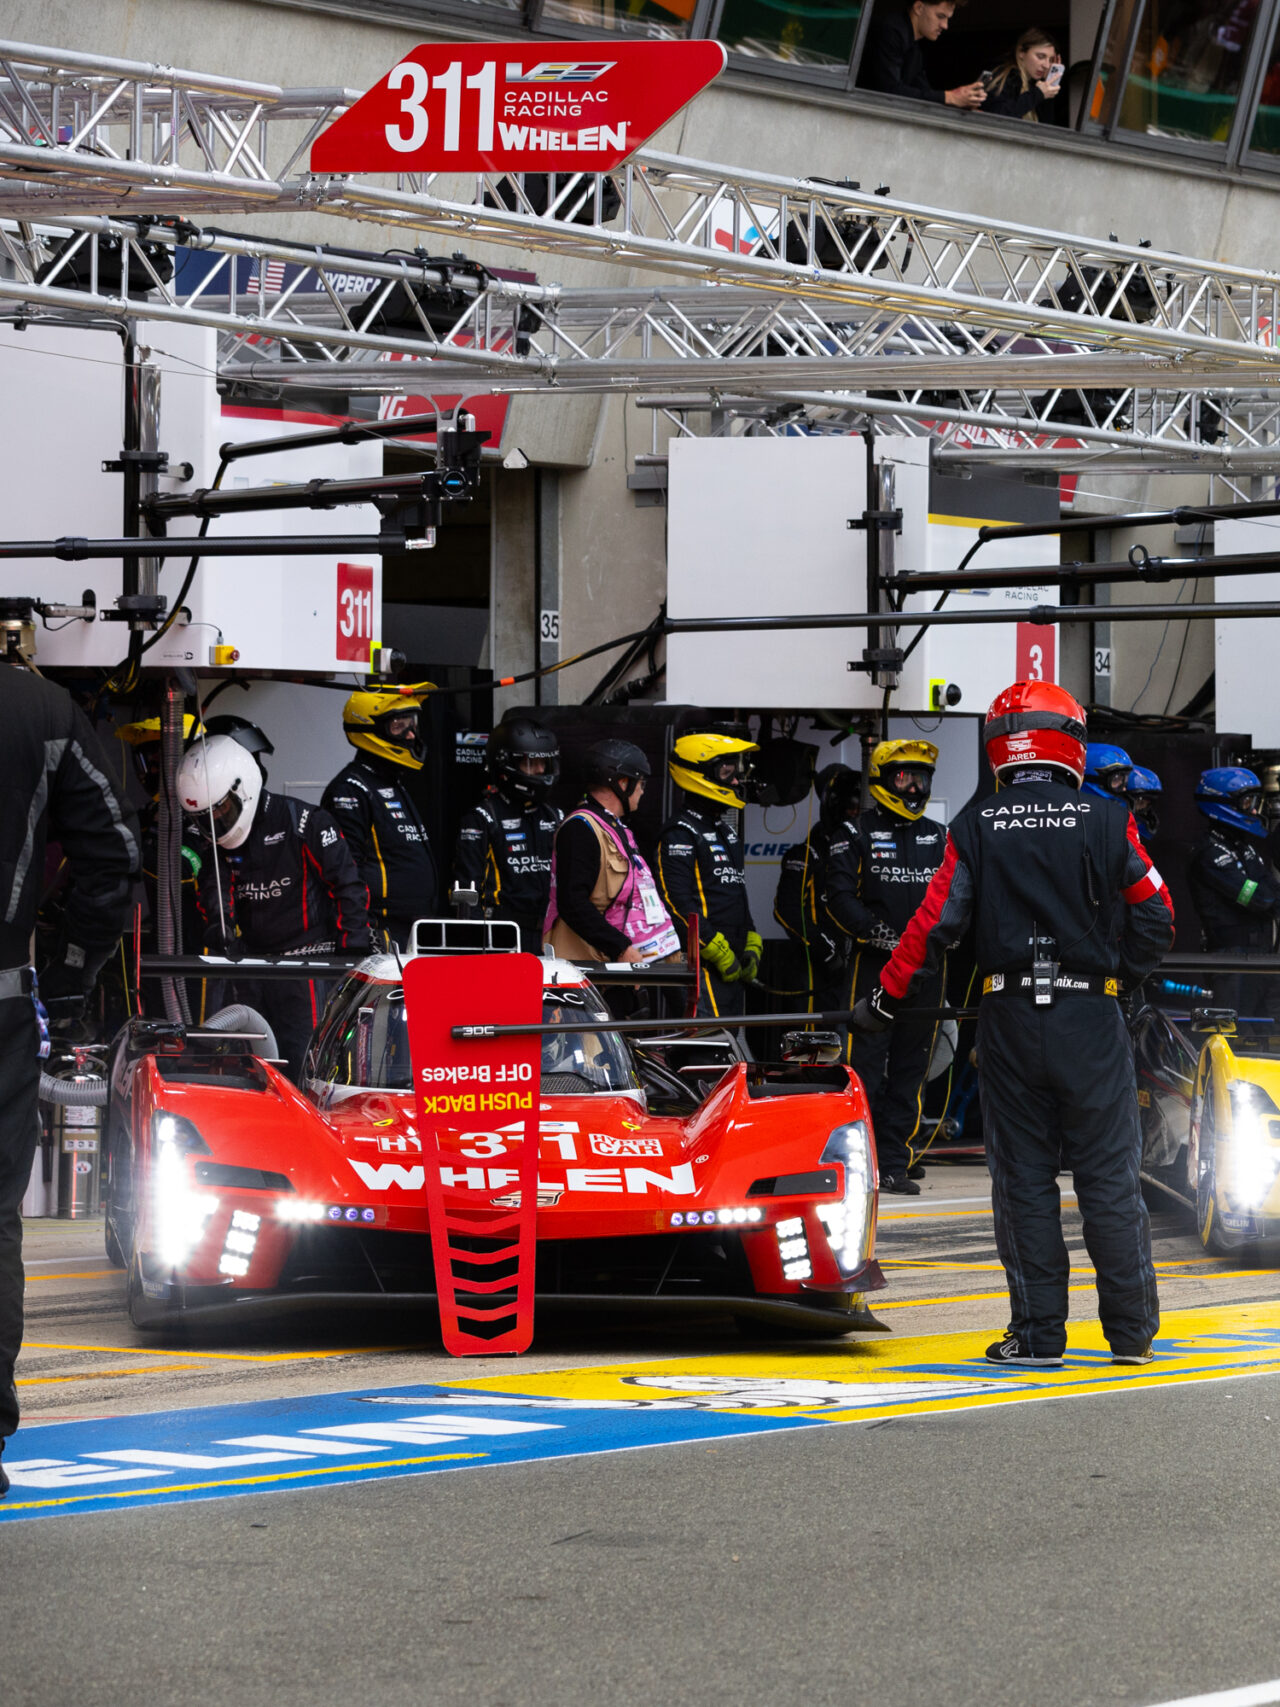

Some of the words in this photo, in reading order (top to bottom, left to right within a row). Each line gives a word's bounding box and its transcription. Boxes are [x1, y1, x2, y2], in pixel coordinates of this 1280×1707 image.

[504, 91, 609, 103] CADILLAC
[385, 61, 497, 153] 311
[504, 105, 583, 117] RACING
[498, 121, 627, 151] WHELEN
[340, 588, 372, 639] 311
[542, 613, 559, 639] 35
[1029, 644, 1043, 680] 3
[1095, 650, 1111, 673] 34
[1007, 752, 1037, 762] JARED
[981, 802, 1091, 817] CADILLAC
[993, 817, 1077, 831] RACING
[744, 843, 790, 857] ICHE
[513, 864, 551, 874] RACIN
[239, 888, 282, 900] ACING
[1021, 976, 1089, 990] mnix.com
[422, 1065, 490, 1084] Brakes
[495, 1063, 532, 1081] OFF
[424, 1093, 476, 1114] BACK
[480, 1091, 533, 1110] PUSH
[459, 1132, 578, 1160] 31
[592, 1134, 660, 1148] HYPER
[597, 1142, 663, 1156] CAR
